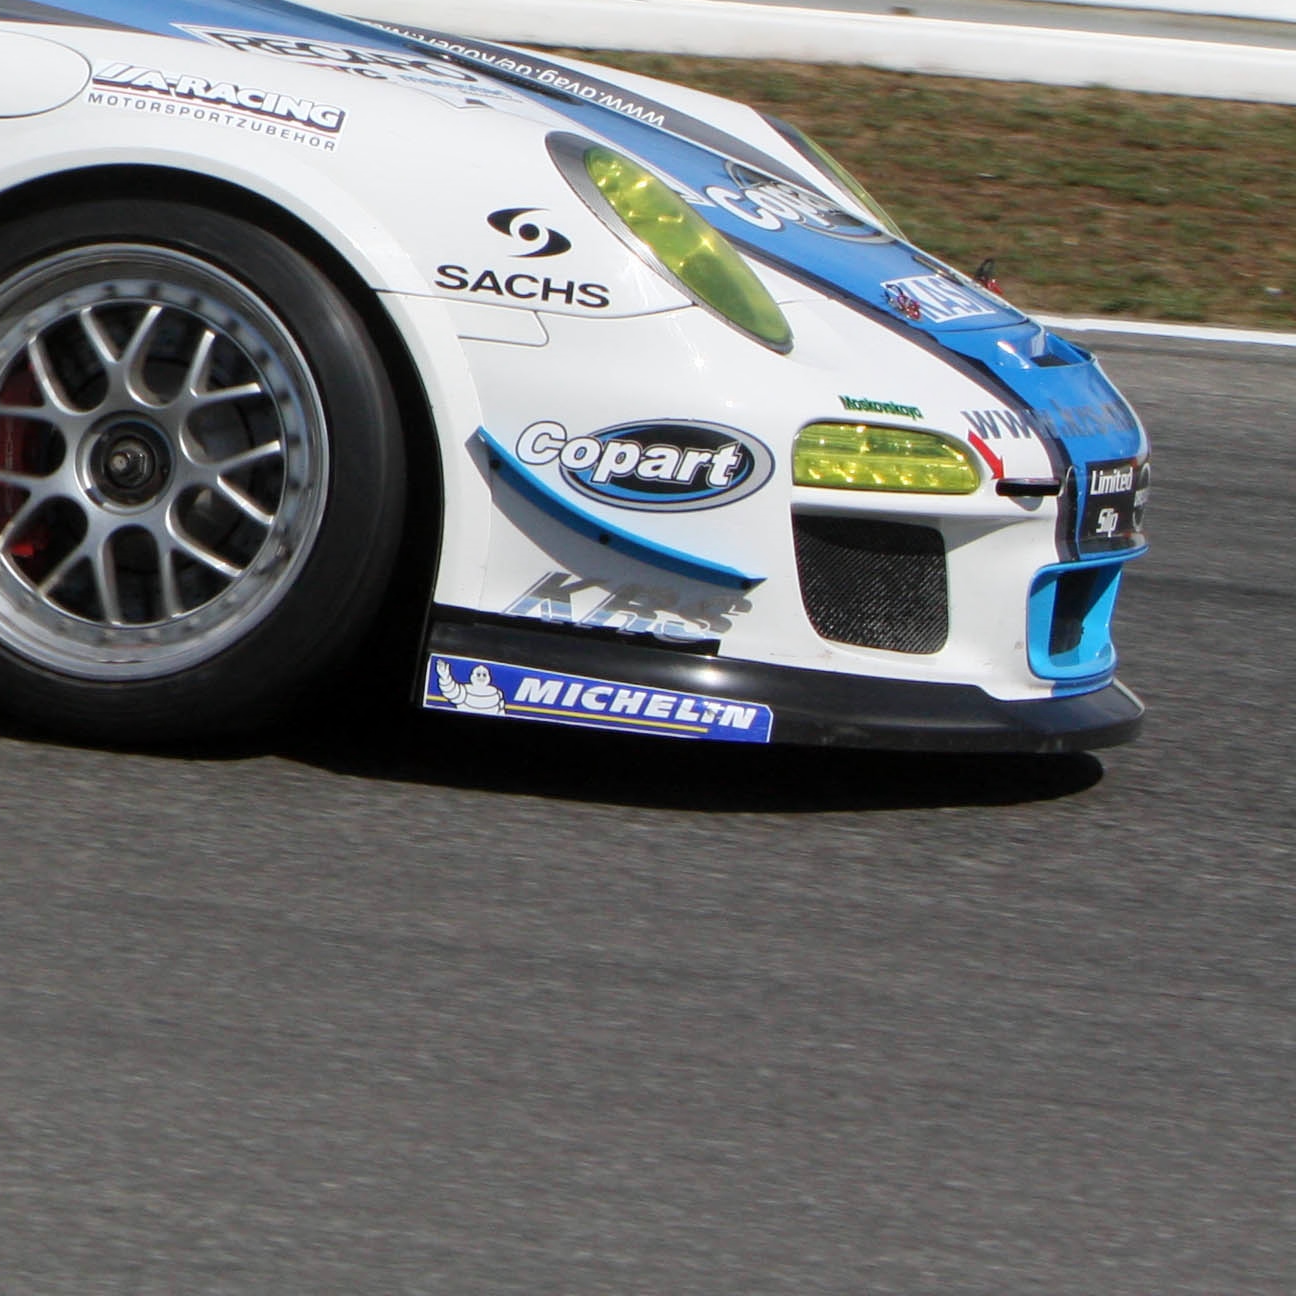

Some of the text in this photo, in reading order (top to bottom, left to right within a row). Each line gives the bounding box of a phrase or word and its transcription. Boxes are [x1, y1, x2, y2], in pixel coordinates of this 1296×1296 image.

[434, 264, 611, 309] SACHS
[516, 420, 742, 487] Copart
[1090, 465, 1133, 496] Limited
[1096, 507, 1119, 538] Slip
[514, 676, 757, 730] MICHELIN
